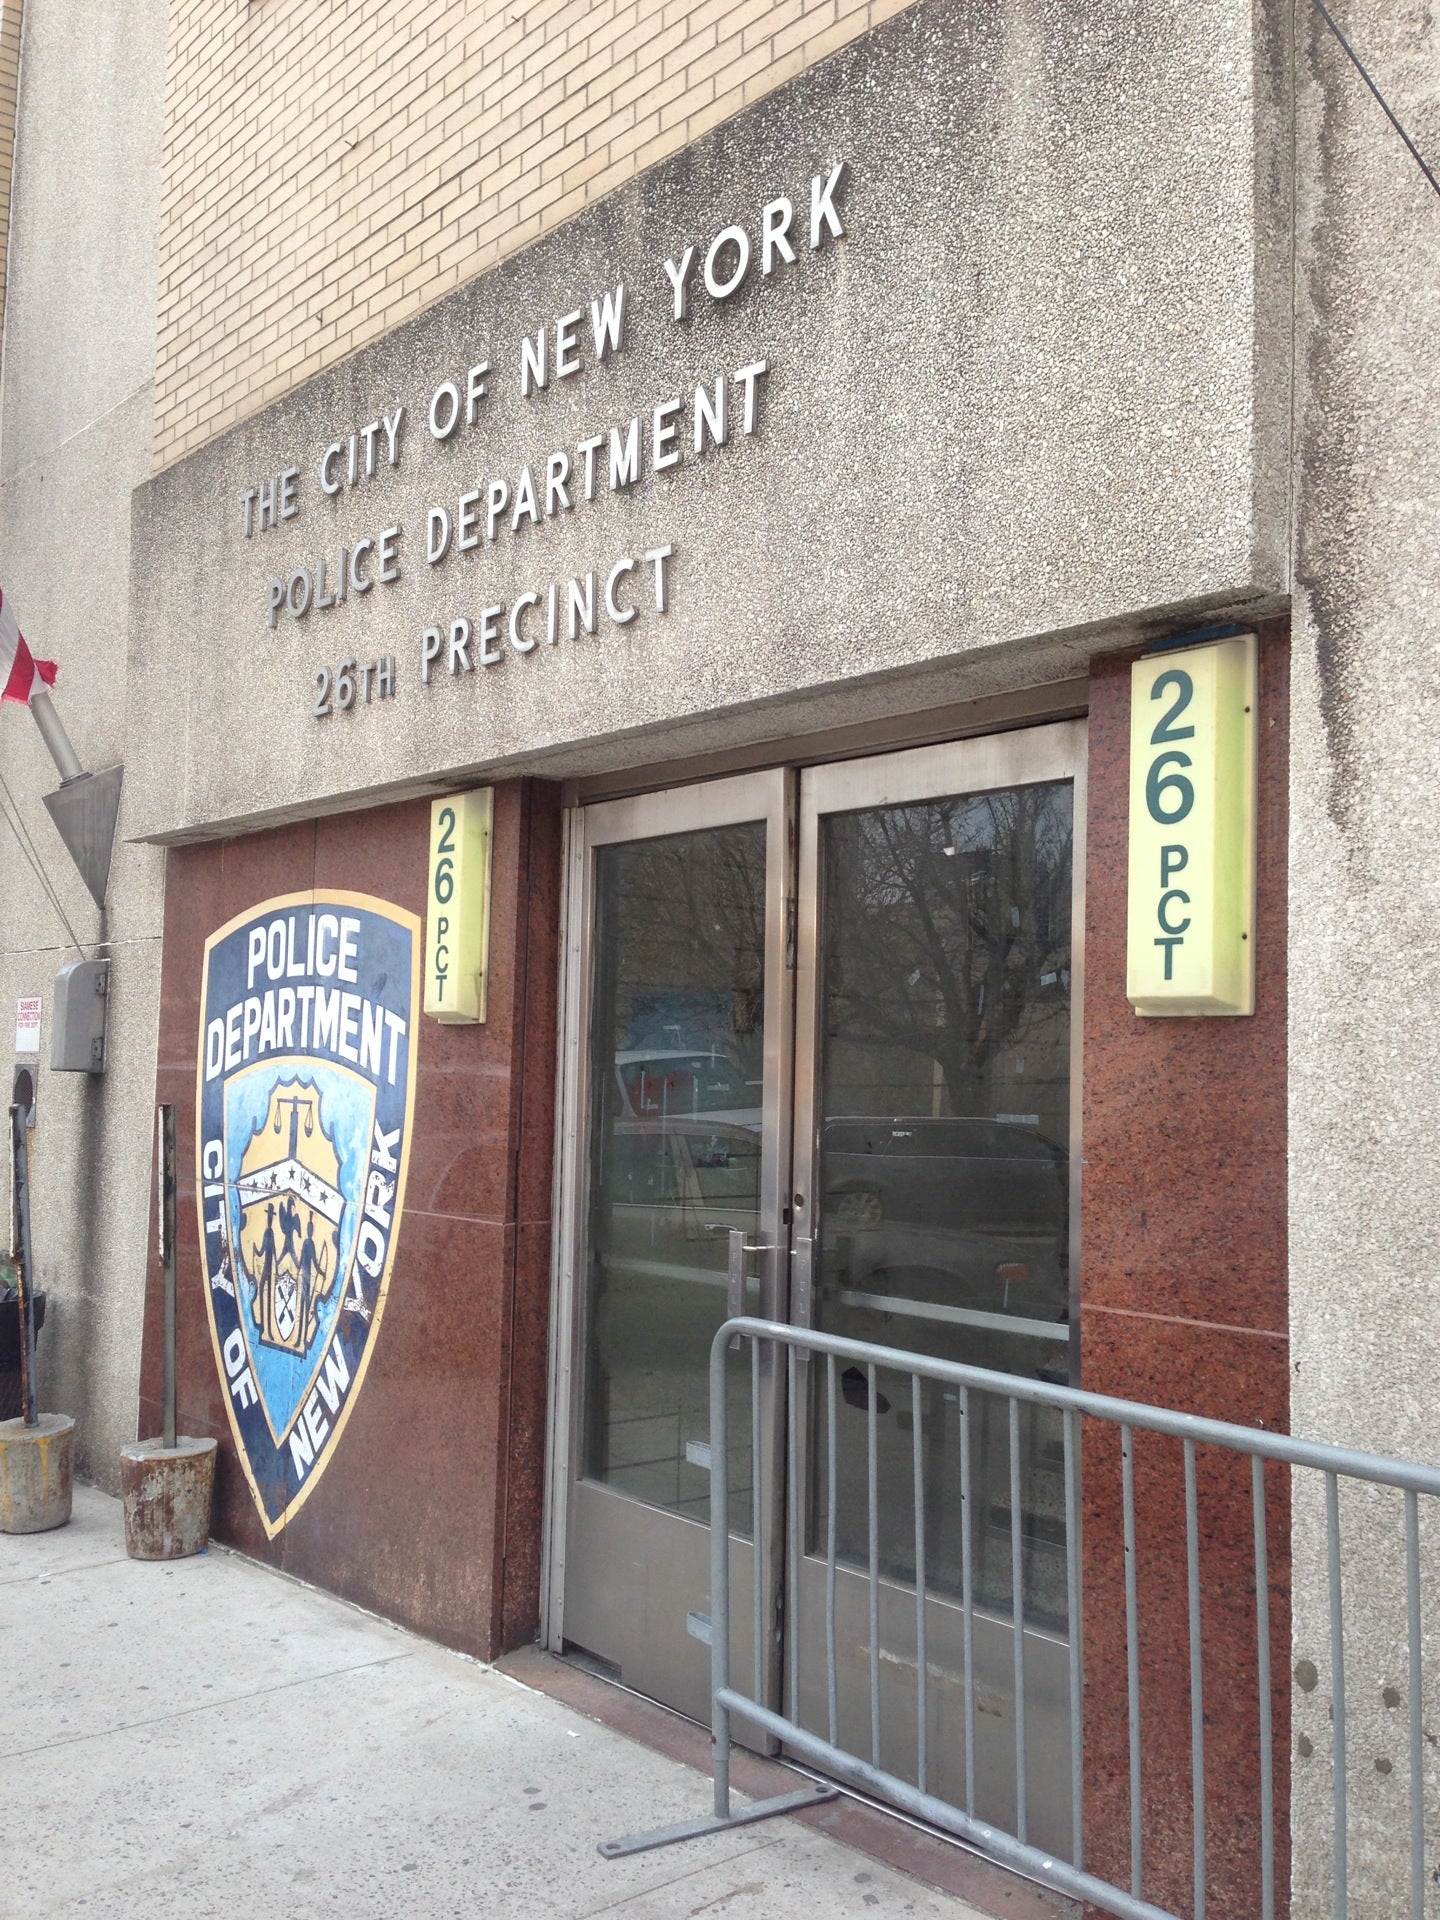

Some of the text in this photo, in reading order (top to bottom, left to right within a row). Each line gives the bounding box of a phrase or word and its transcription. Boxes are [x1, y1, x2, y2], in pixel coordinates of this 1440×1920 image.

[242, 163, 848, 537] THE CITY OF NEW YORK
[268, 360, 770, 628] POLICE DEPARTMENT
[313, 543, 677, 718] 26TH PRECINCT
[247, 914, 361, 989] POLICE
[435, 807, 456, 1001] 26 PCT
[1145, 669, 1195, 981] 26 PCT
[206, 985, 406, 1086] DEPARTMENT
[203, 1139, 258, 1411] CITY OF
[288, 1118, 400, 1481] NEW YORK
